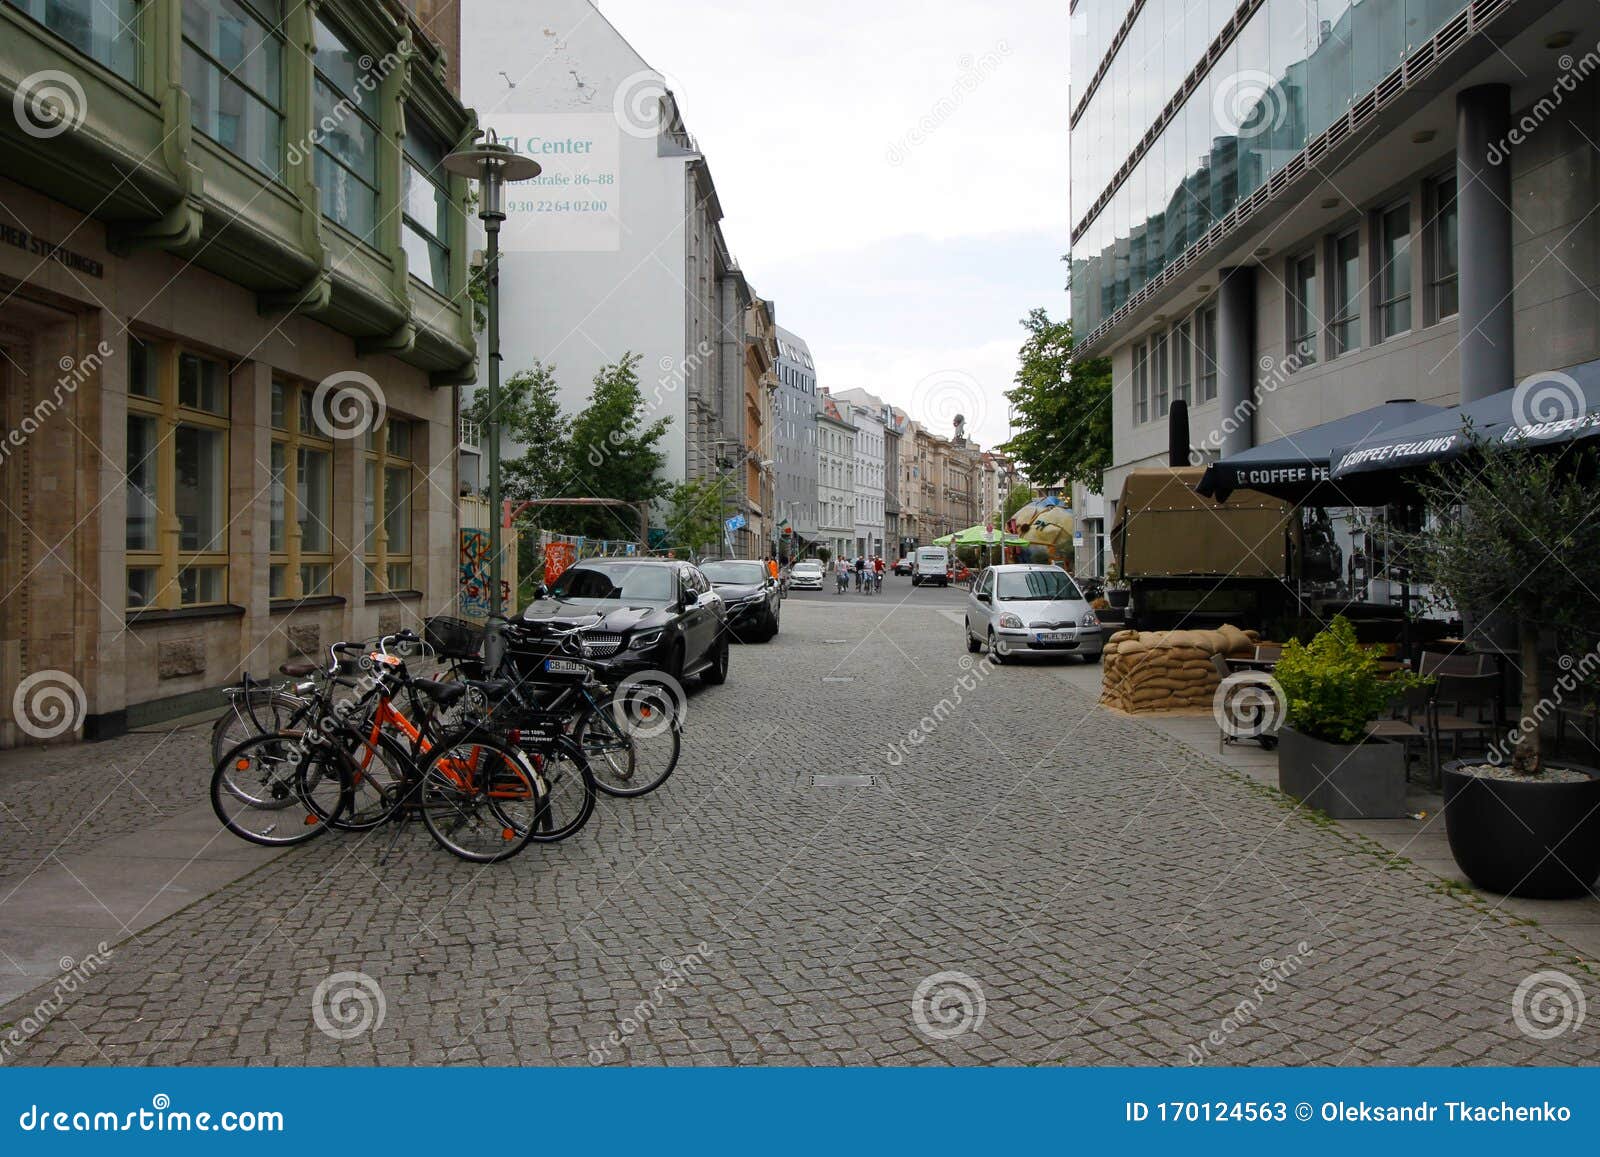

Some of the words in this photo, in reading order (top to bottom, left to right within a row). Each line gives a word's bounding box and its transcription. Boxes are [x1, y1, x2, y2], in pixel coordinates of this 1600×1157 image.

[498, 136, 523, 154] TL
[527, 137, 592, 154] Center
[0, 223, 28, 250] HER
[1344, 444, 1393, 468] COFFEE
[1388, 435, 1457, 459] FELLOWS
[1249, 467, 1306, 484] COFFEE
[1311, 467, 1329, 481] FE
